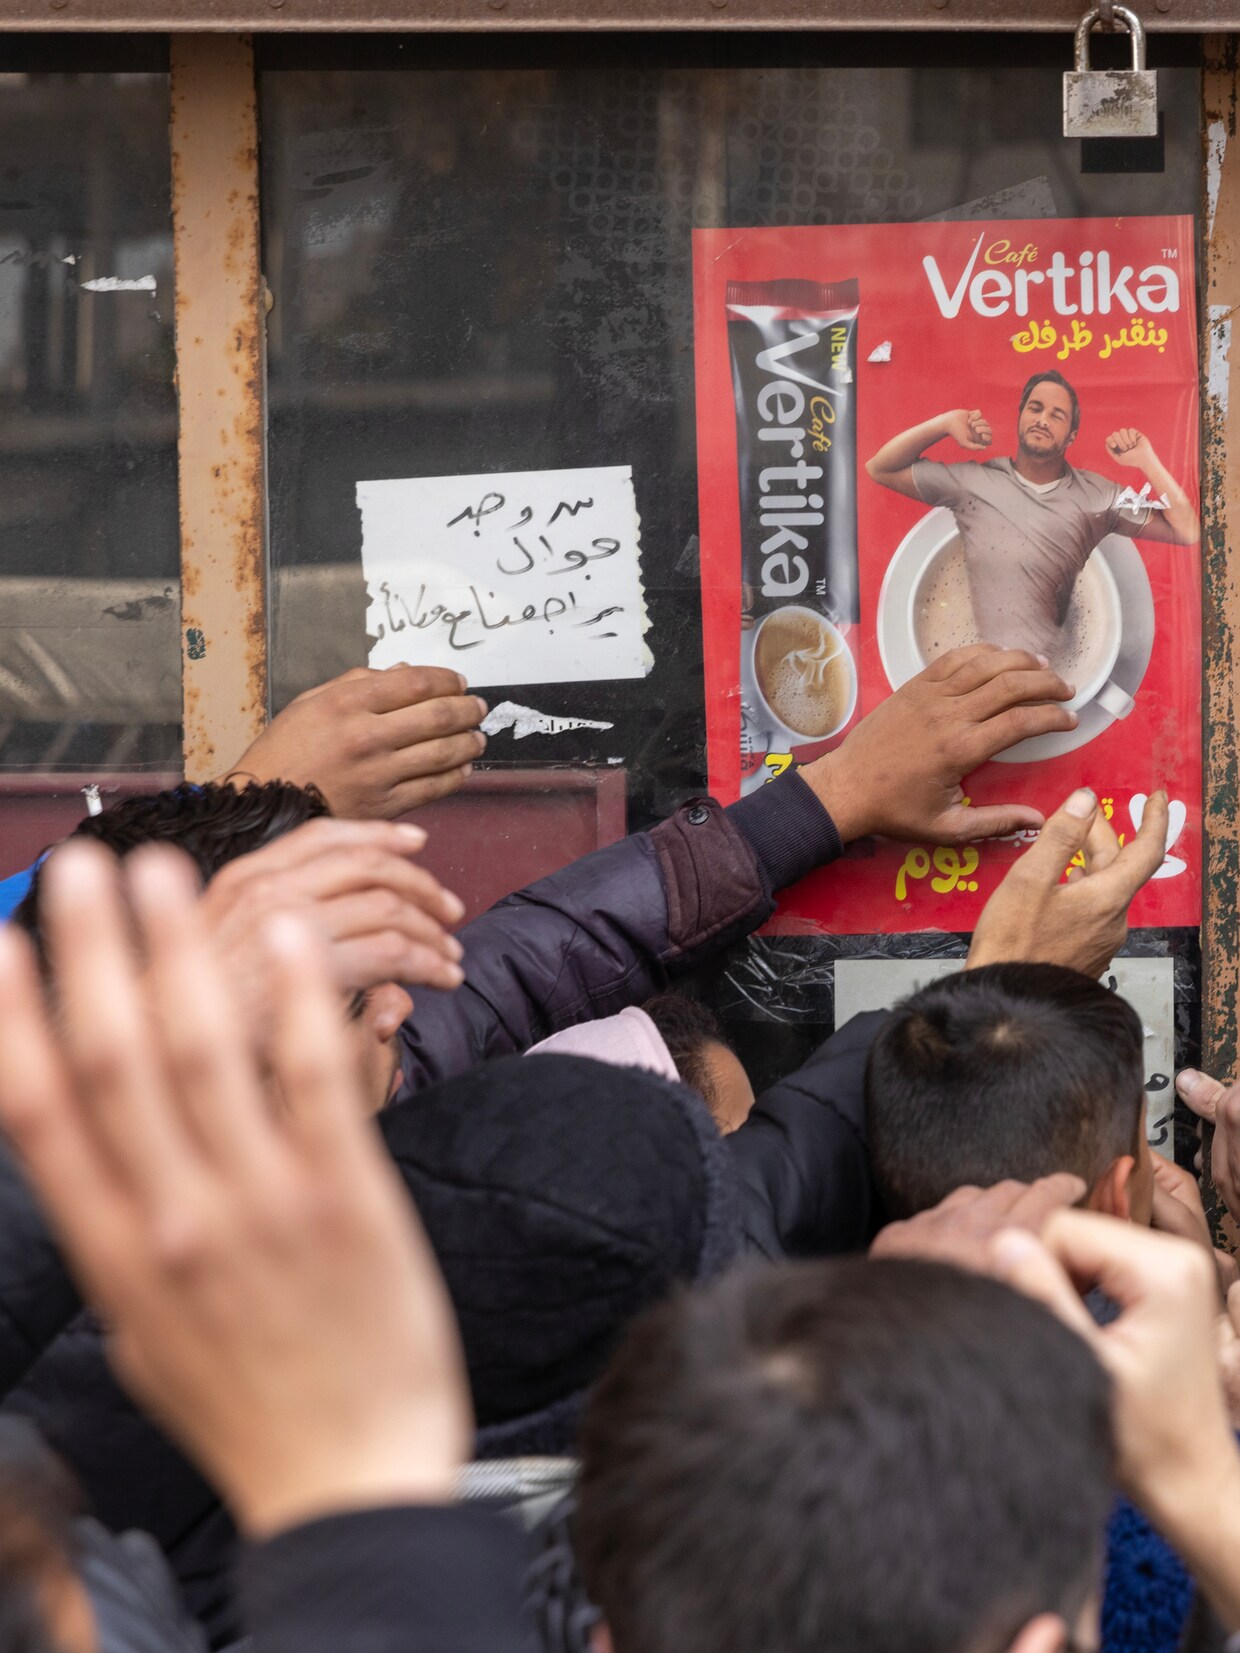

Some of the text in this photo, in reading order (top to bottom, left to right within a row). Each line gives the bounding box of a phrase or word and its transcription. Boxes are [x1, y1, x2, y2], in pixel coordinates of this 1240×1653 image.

[922, 231, 1180, 319] Vertika
[984, 239, 1038, 268] Café
[831, 327, 846, 371] NEW
[1011, 318, 1169, 360] بنقدر ظرفك
[807, 396, 836, 452] Café
[755, 332, 844, 598] Vertika
[496, 535, 621, 581] جوال
[894, 846, 980, 901] يوم
